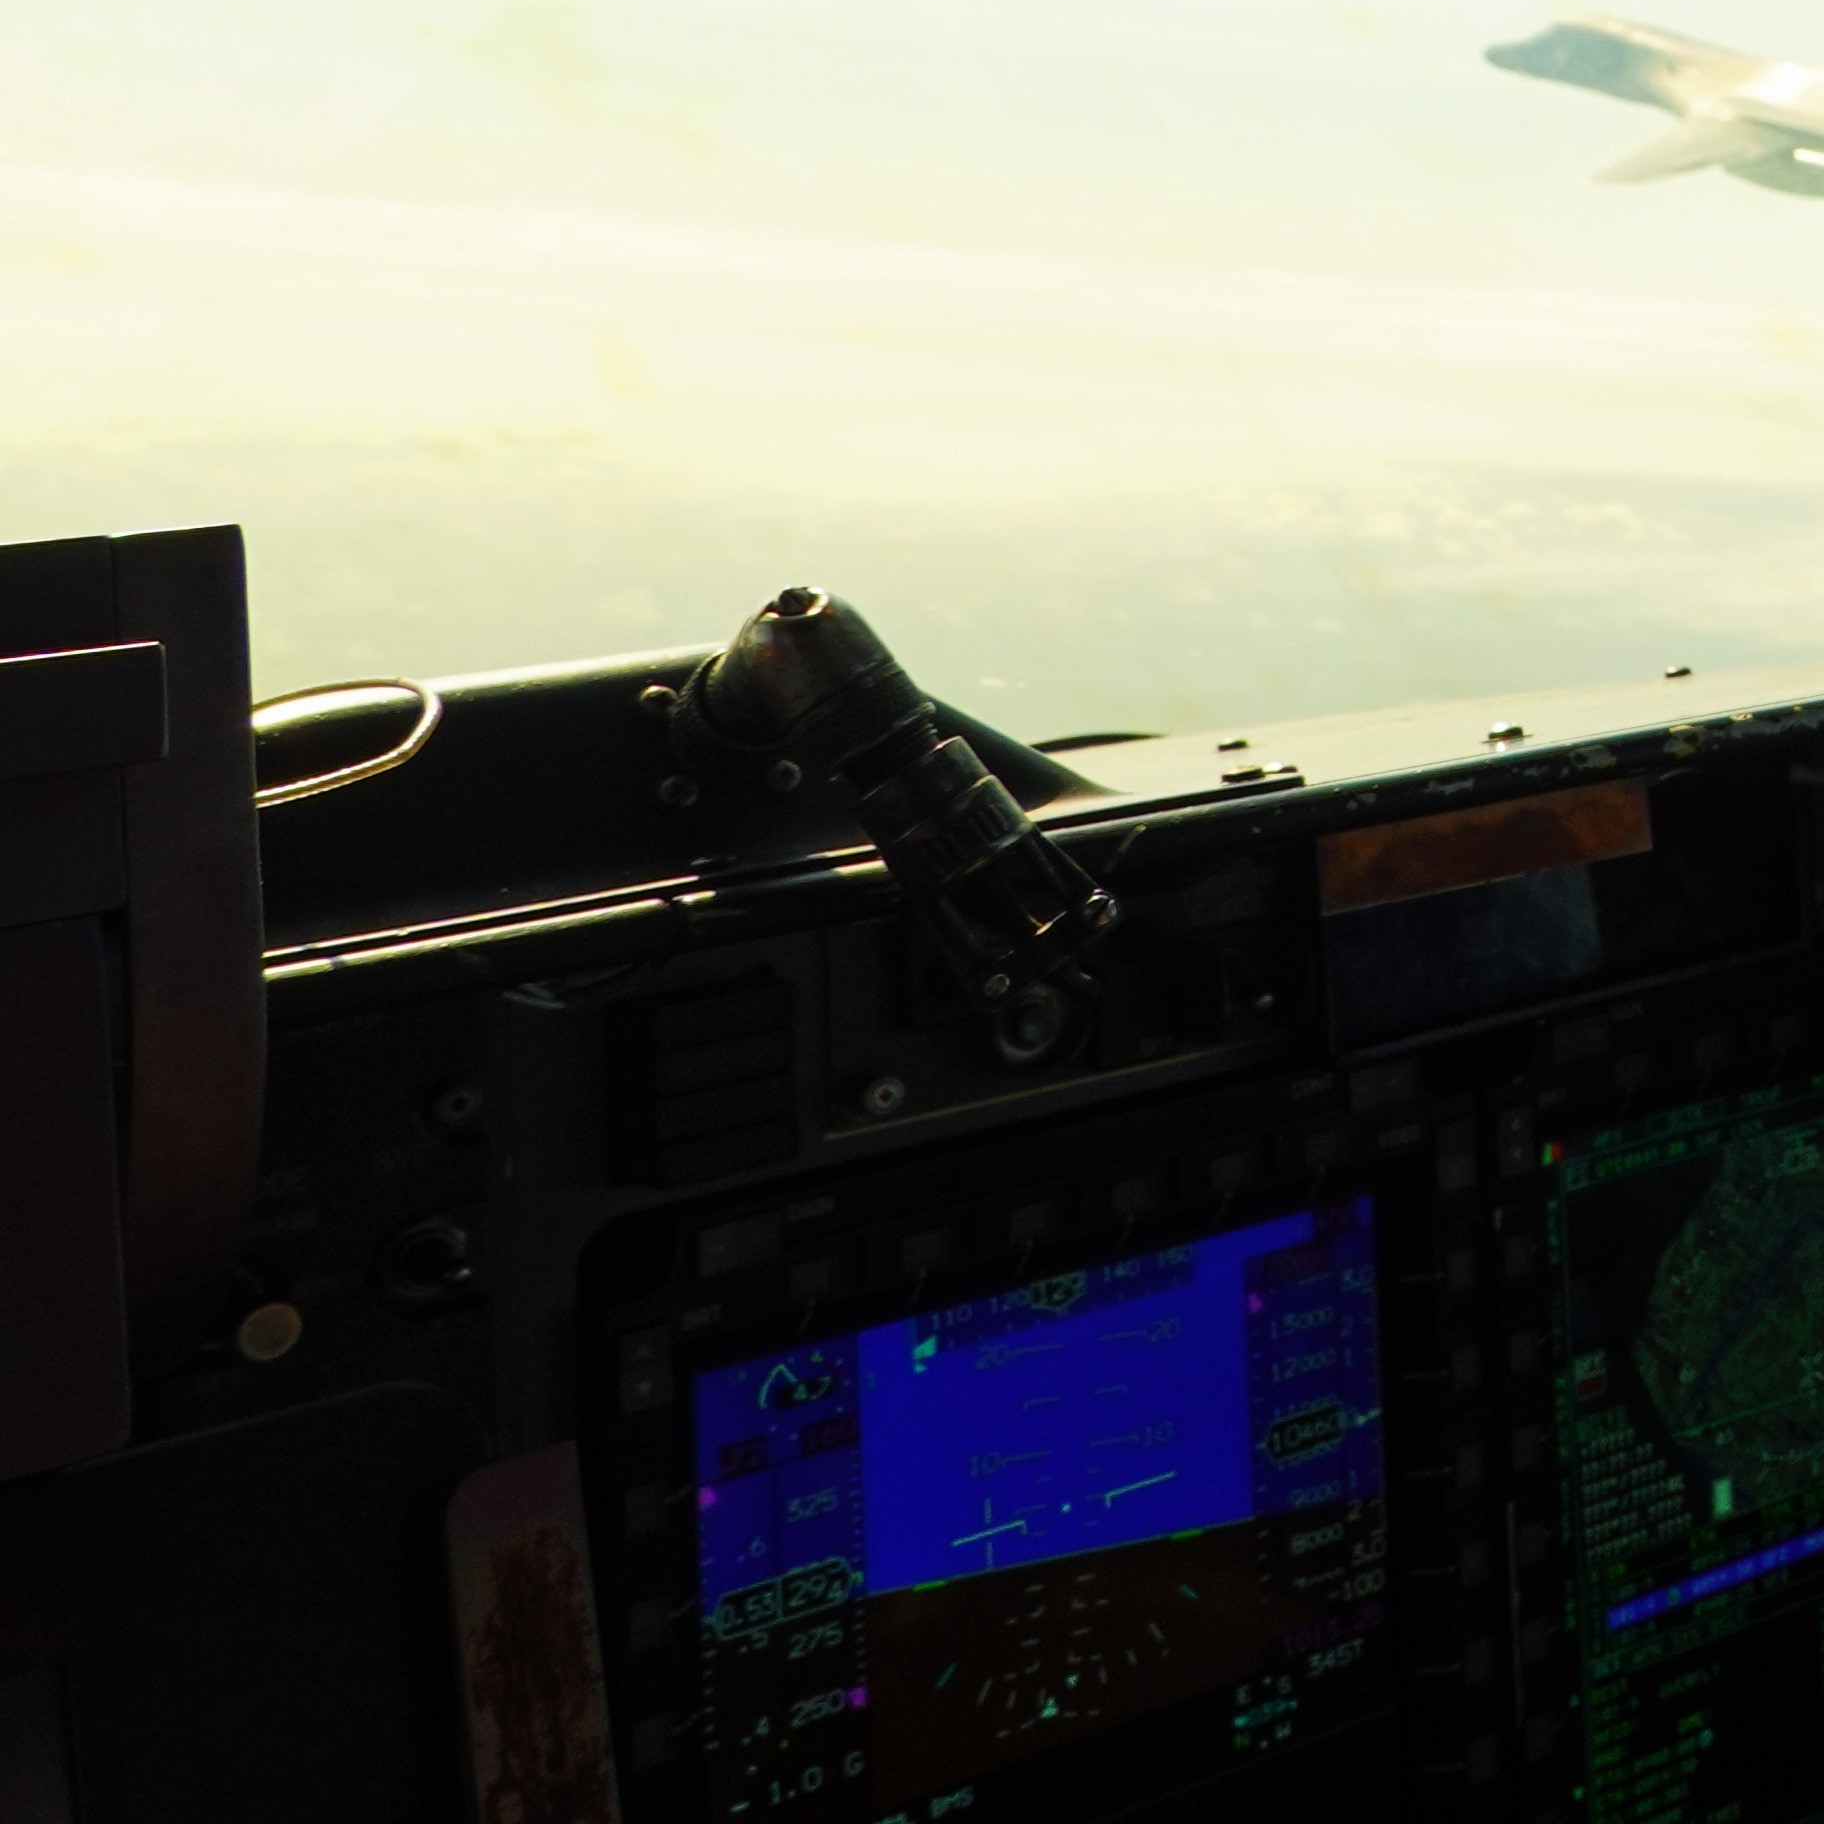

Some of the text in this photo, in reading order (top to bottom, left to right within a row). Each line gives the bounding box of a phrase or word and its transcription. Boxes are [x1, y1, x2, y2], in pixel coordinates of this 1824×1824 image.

[932, 1304, 974, 1330] 110
[720, 1590, 775, 1629] 0.53
[787, 1620, 845, 1661] 275
[789, 1687, 846, 1730] 250
[768, 1750, 866, 1806] 1.0 G
